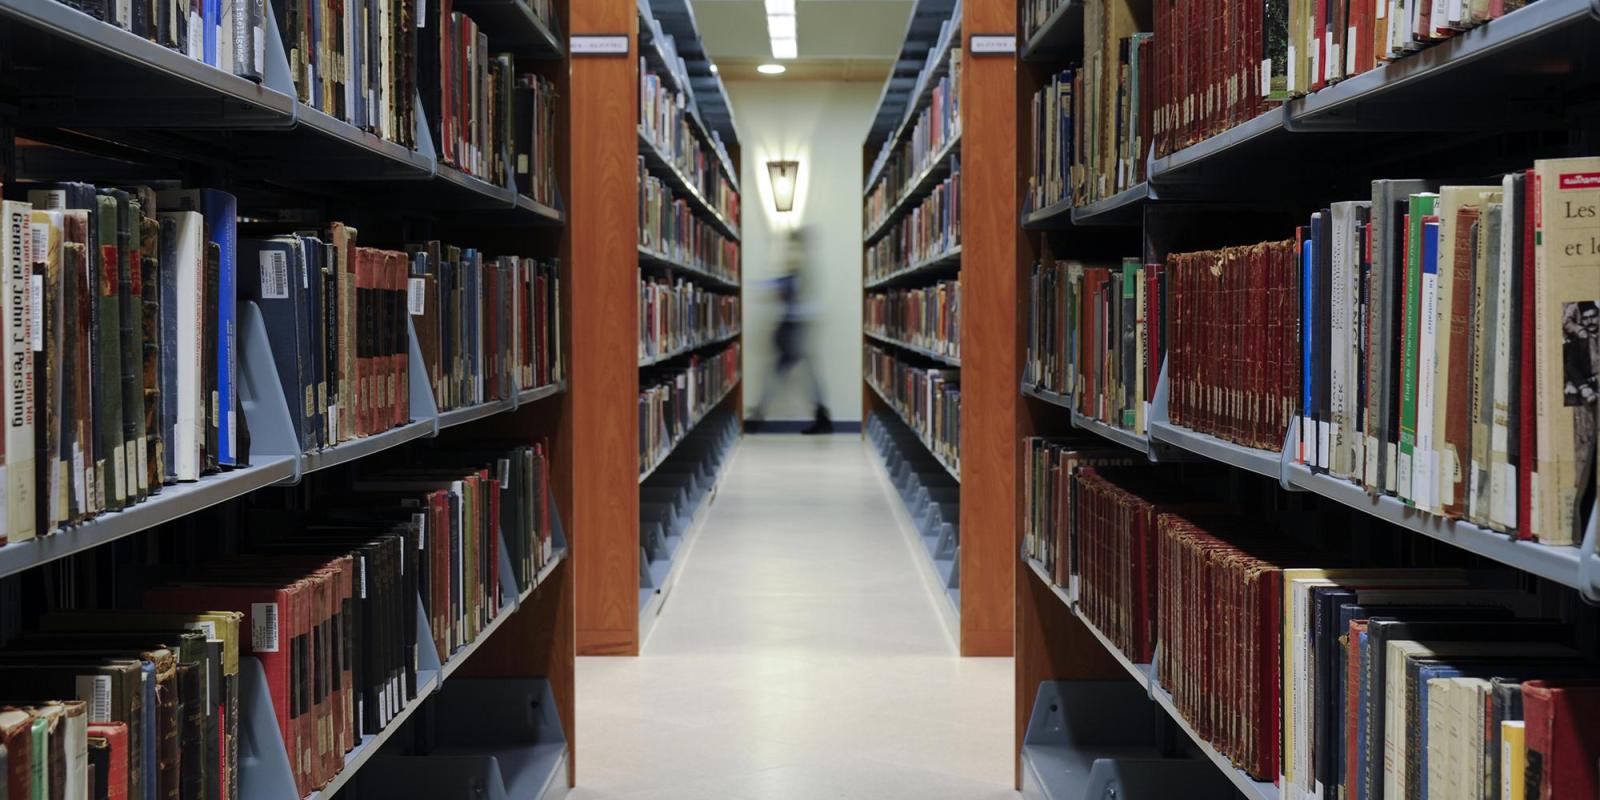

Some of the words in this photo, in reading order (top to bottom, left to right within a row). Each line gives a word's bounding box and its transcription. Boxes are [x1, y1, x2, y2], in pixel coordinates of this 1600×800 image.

[1564, 201, 1596, 218] Les
[12, 213, 23, 280] General
[23, 233, 31, 301] Experiences
[1564, 243, 1583, 256] et
[13, 285, 23, 328] John
[11, 352, 25, 427] Pershing
